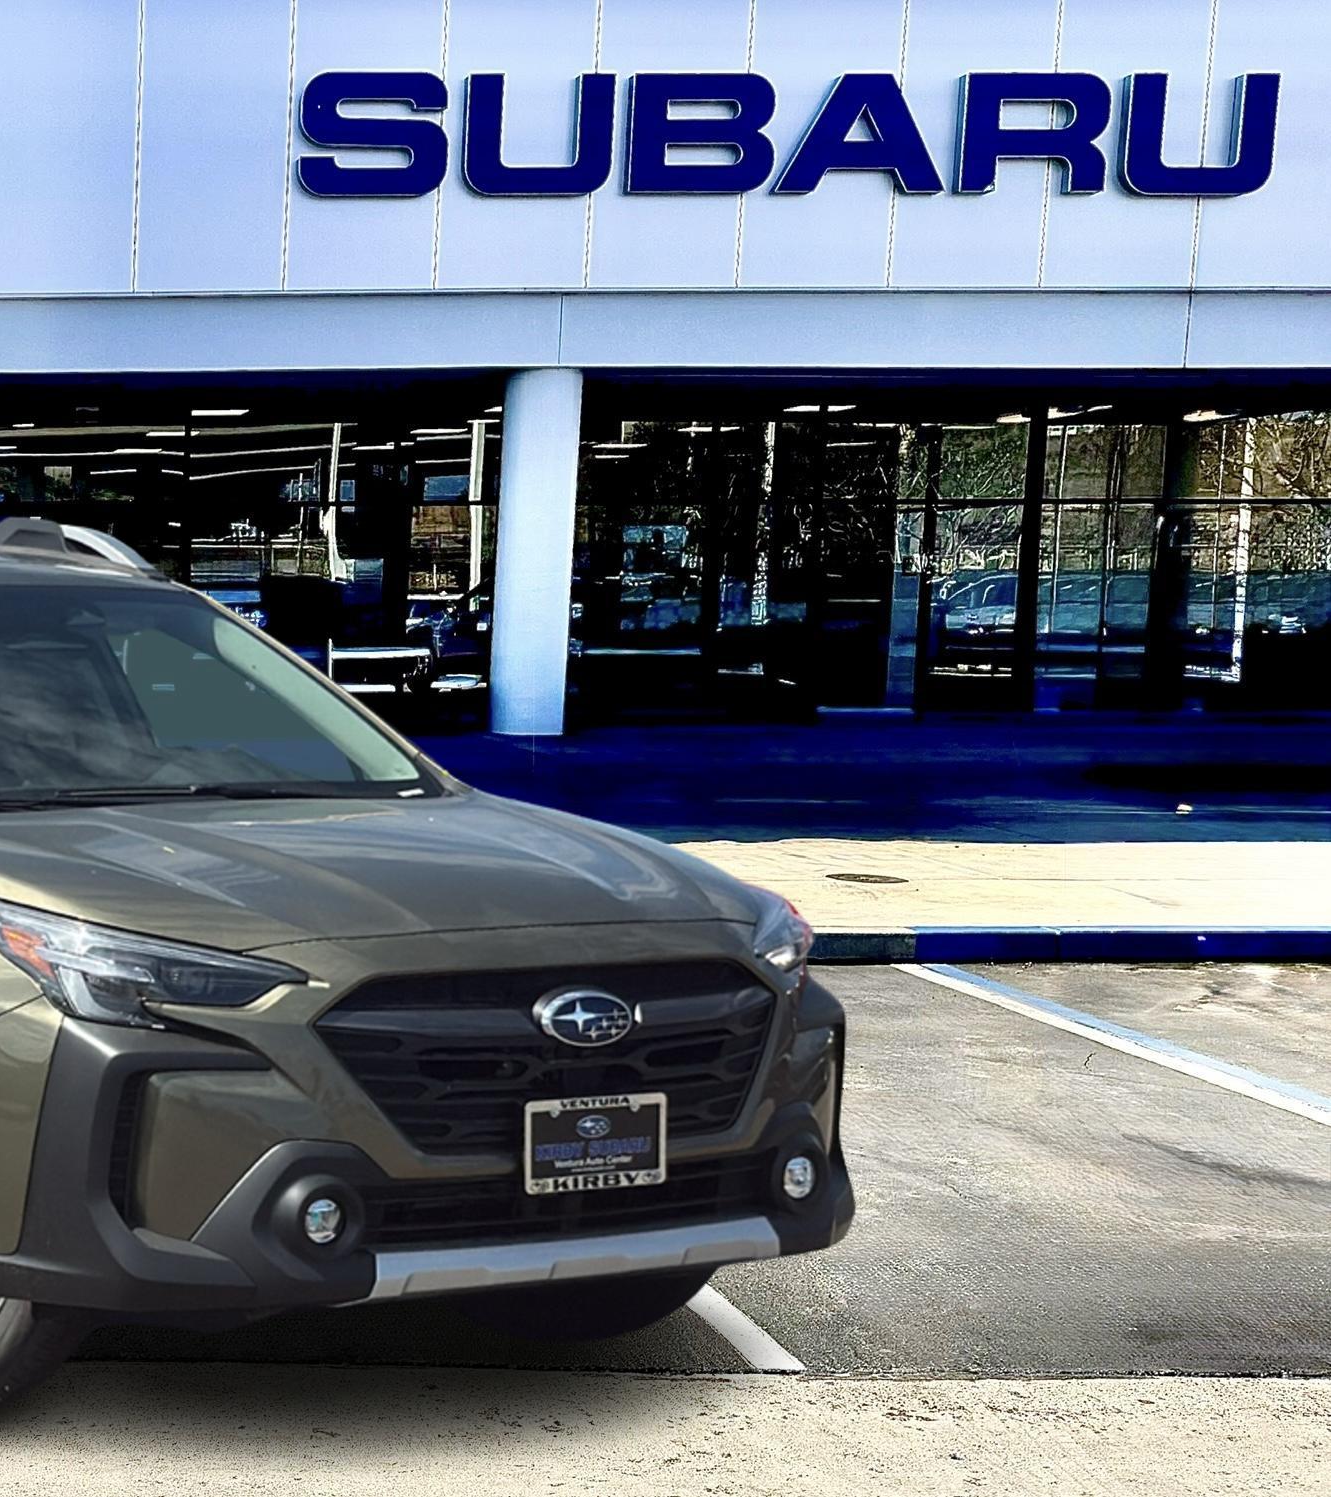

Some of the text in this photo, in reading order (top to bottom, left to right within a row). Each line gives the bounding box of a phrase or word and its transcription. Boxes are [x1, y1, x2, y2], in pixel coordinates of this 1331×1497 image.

[298, 71, 1281, 198] SUBARU
[560, 1096, 630, 1109] VENTURA
[554, 1159, 584, 1169] Ventura
[585, 1157, 605, 1166] Auto
[606, 1154, 633, 1165] Center
[554, 1172, 640, 1191] KIRBY
